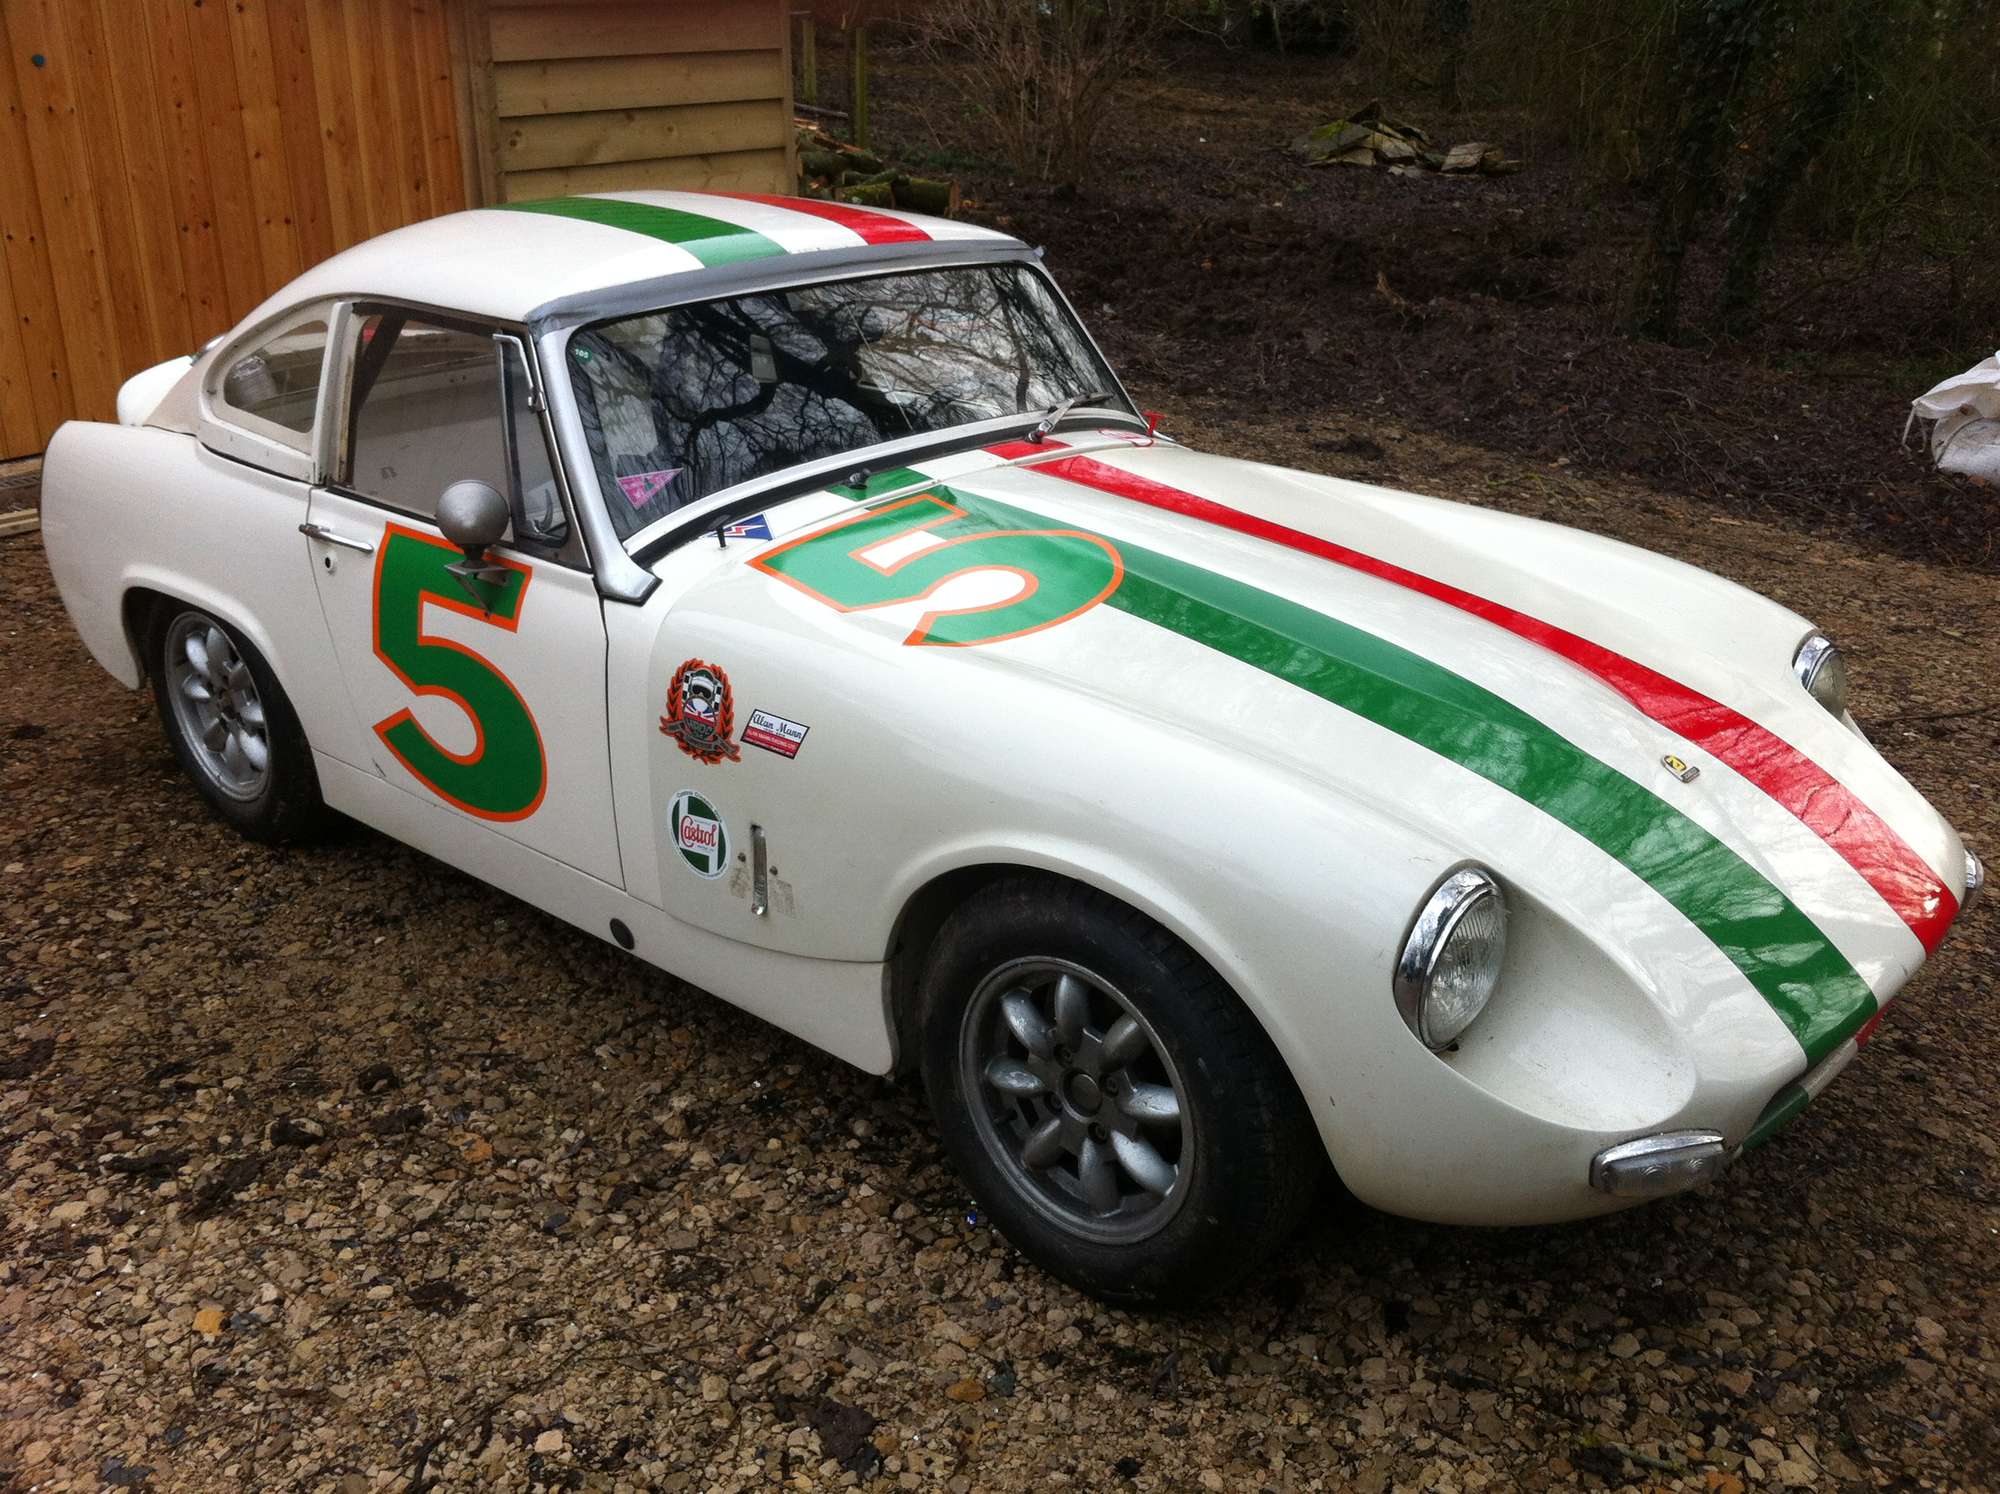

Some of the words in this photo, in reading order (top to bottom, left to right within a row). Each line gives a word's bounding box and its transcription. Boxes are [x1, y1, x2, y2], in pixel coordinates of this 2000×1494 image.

[744, 493, 1124, 647] 5
[372, 521, 547, 822] 5
[752, 713, 774, 730] Alan
[776, 722, 802, 740] Mann
[680, 815, 717, 848] Castrol
